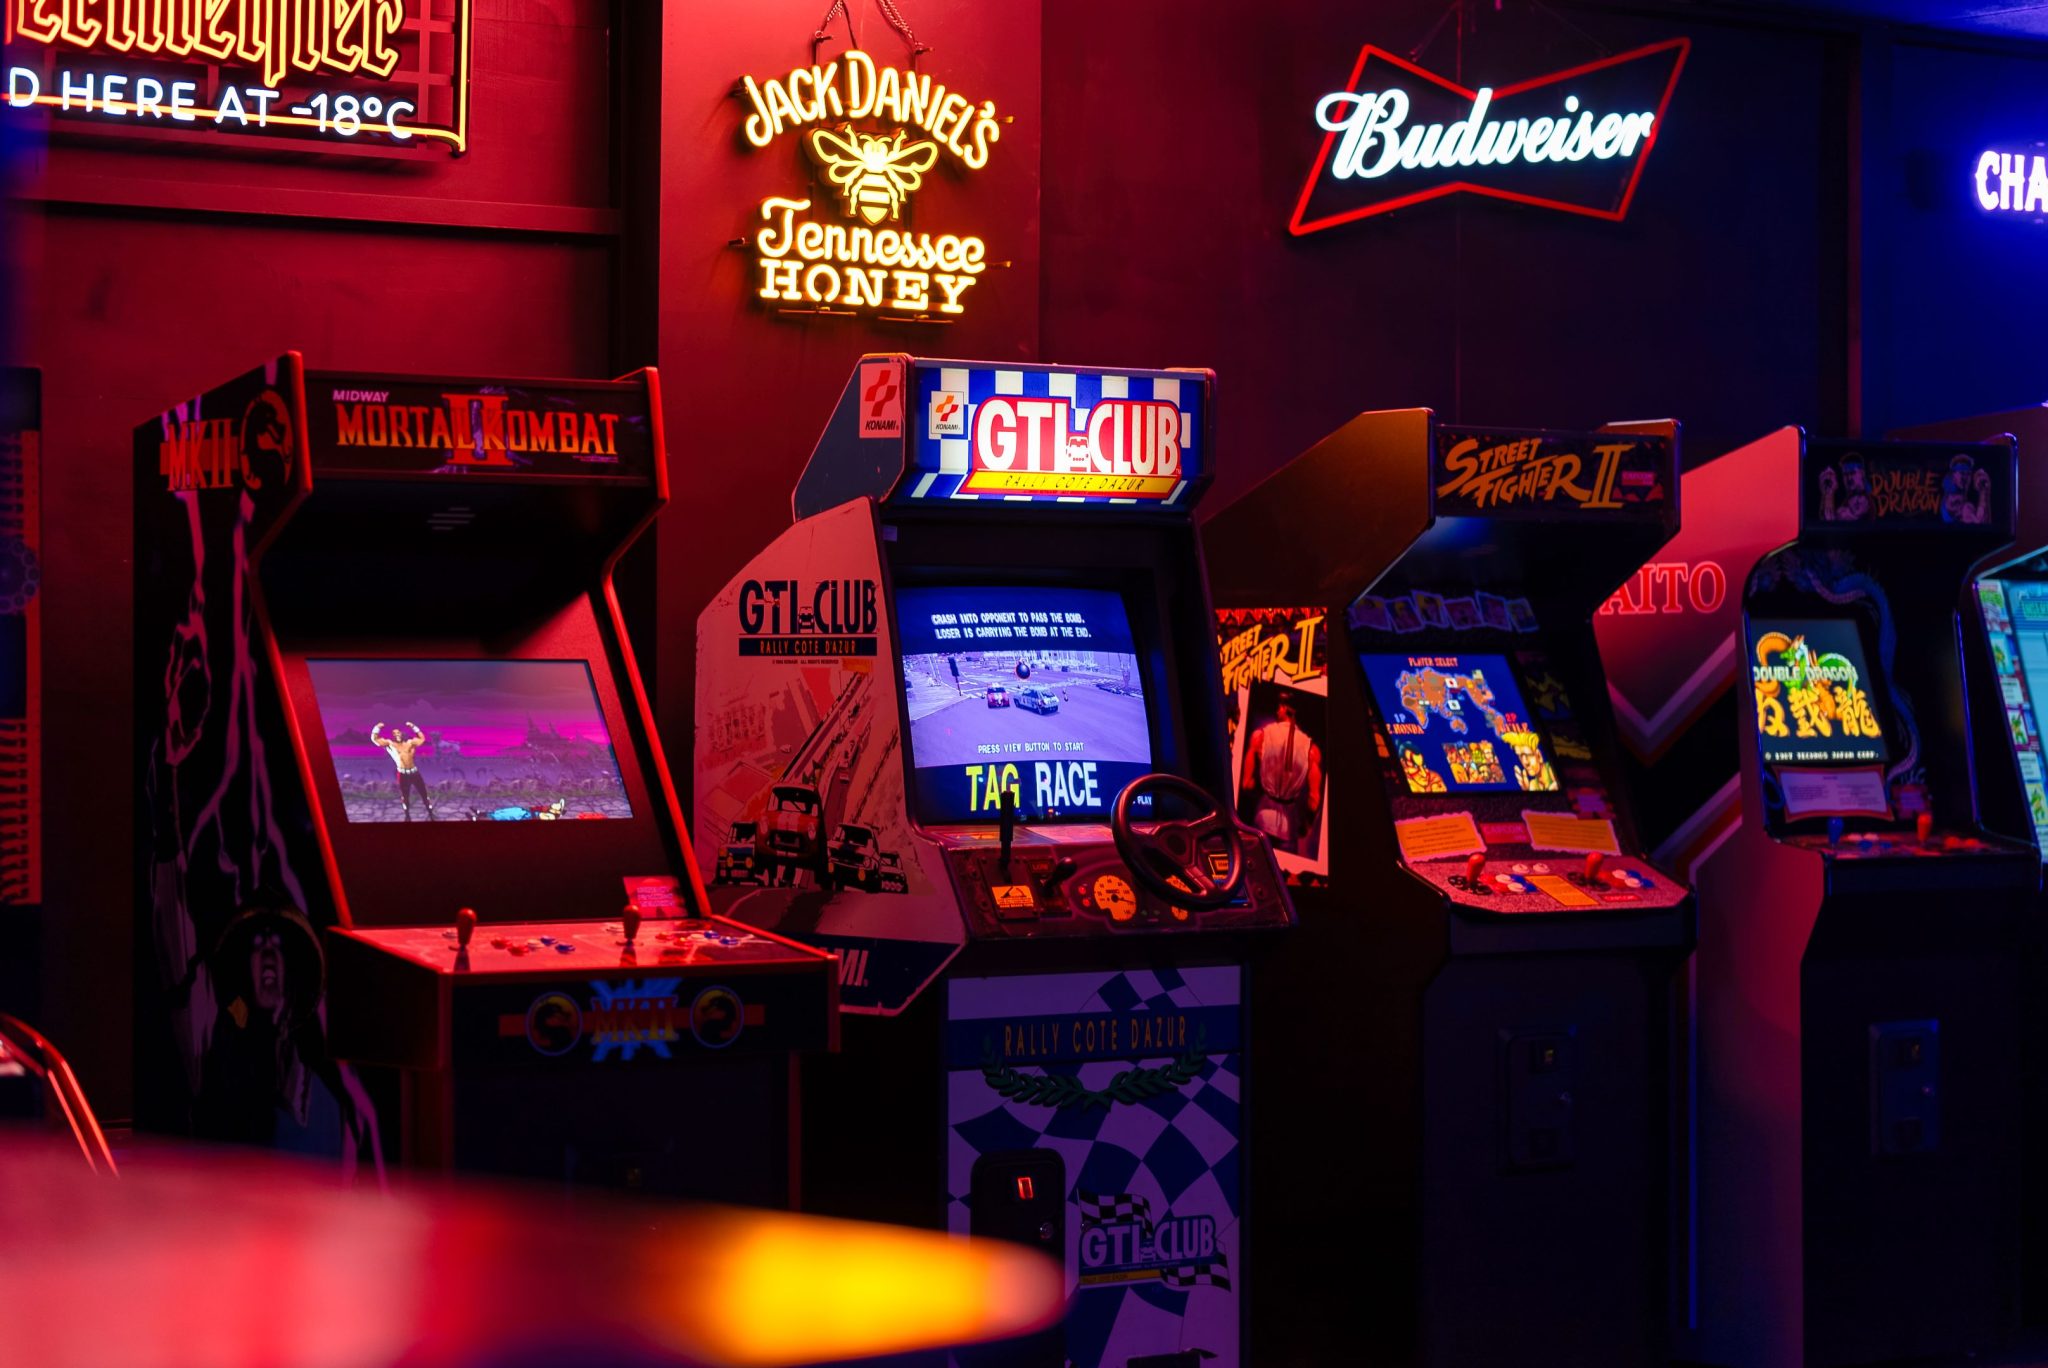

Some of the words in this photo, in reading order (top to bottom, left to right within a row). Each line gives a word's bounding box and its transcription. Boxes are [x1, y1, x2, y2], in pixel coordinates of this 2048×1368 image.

[61, 70, 196, 121] HERE
[214, 86, 280, 128] AT
[745, 61, 844, 147] JACK
[844, 50, 1001, 170] DANIEL'S
[1315, 87, 1655, 179] Budweiser
[1975, 150, 2048, 213] CHA
[757, 196, 986, 273] Tennessee
[759, 258, 977, 314] HONEY
[332, 389, 389, 404] MIDWAY
[335, 403, 472, 450] MORTAL
[482, 408, 620, 456] KOMBAT
[865, 420, 897, 431] KONAMI
[977, 399, 1070, 471] GTI
[1089, 403, 1181, 475] CLUB
[1005, 475, 1046, 488] RALLY
[1056, 476, 1093, 489] COTE
[1436, 438, 1543, 498] STREET
[1458, 454, 1592, 509] FIGHTER
[1579, 444, 1636, 509] II
[1870, 469, 1941, 496] DOUBLE
[1874, 491, 1942, 518] DRAGON
[739, 580, 798, 634] GTI
[813, 579, 877, 634] CLUB
[931, 613, 957, 625] CRASH
[959, 613, 978, 624] INTO
[980, 612, 1016, 623] OPPONENT
[1018, 612, 1029, 623] TO
[1030, 612, 1048, 623] PASS
[1049, 612, 1064, 623] THE
[760, 640, 789, 654] RALLY
[794, 640, 819, 654] COTE
[825, 640, 857, 654] D'AZUR
[935, 627, 961, 639] LOSER
[963, 627, 974, 638] IS
[975, 626, 1012, 637] CARRYING
[1013, 626, 1028, 637] THE
[1029, 626, 1048, 637] BOMB
[1050, 626, 1058, 637] AT
[1060, 627, 1074, 637] THE
[1217, 624, 1263, 664] TREET
[1222, 634, 1298, 696] FIGHTER
[1291, 616, 1325, 682] II
[1408, 657, 1434, 668] PLAYER
[1435, 657, 1458, 668] SELECT
[1753, 666, 1801, 681] DOUBLE
[1805, 666, 1858, 681] DRAGON
[1394, 713, 1407, 723] 1P
[1505, 712, 1517, 723] 2P
[977, 744, 1000, 754] PRESS
[1004, 743, 1021, 753] VIEW
[1025, 742, 1050, 752] BUTTON
[1053, 742, 1062, 752] TO
[1065, 742, 1085, 752] START
[965, 763, 1021, 812] TAG
[1035, 761, 1101, 808] RACE
[1004, 1023, 1060, 1057] RALLY
[1072, 1018, 1119, 1054] COTE
[1081, 1224, 1141, 1267] GTI
[1154, 1217, 1214, 1260] CLUB
